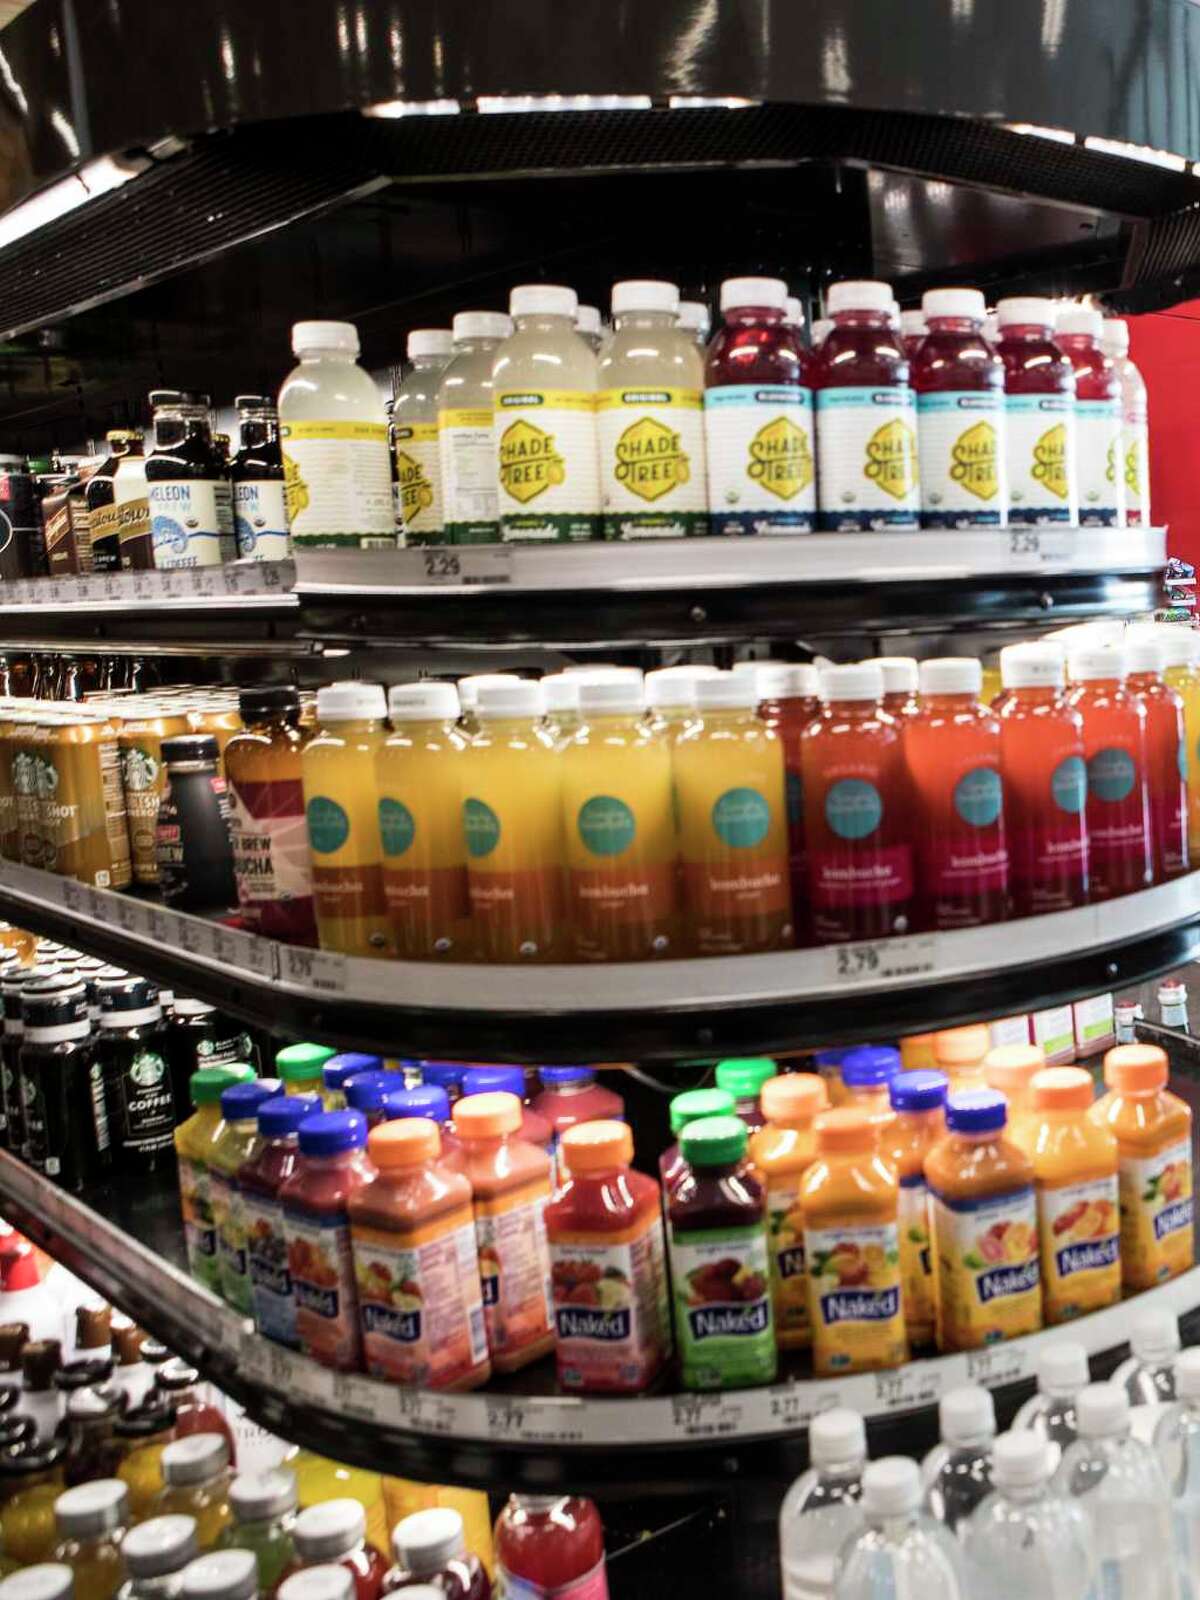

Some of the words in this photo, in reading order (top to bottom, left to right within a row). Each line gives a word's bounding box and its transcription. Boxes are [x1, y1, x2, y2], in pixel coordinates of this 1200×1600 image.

[615, 433, 682, 462] SHADE
[629, 461, 673, 485] TREE
[425, 557, 460, 576] 2.29
[128, 1094, 172, 1111] COFFEE
[1060, 1239, 1120, 1273] Naked
[981, 1262, 1041, 1297] Naked
[826, 1292, 897, 1320] Naked
[558, 1312, 628, 1338] Naked
[695, 1306, 766, 1335] Naked
